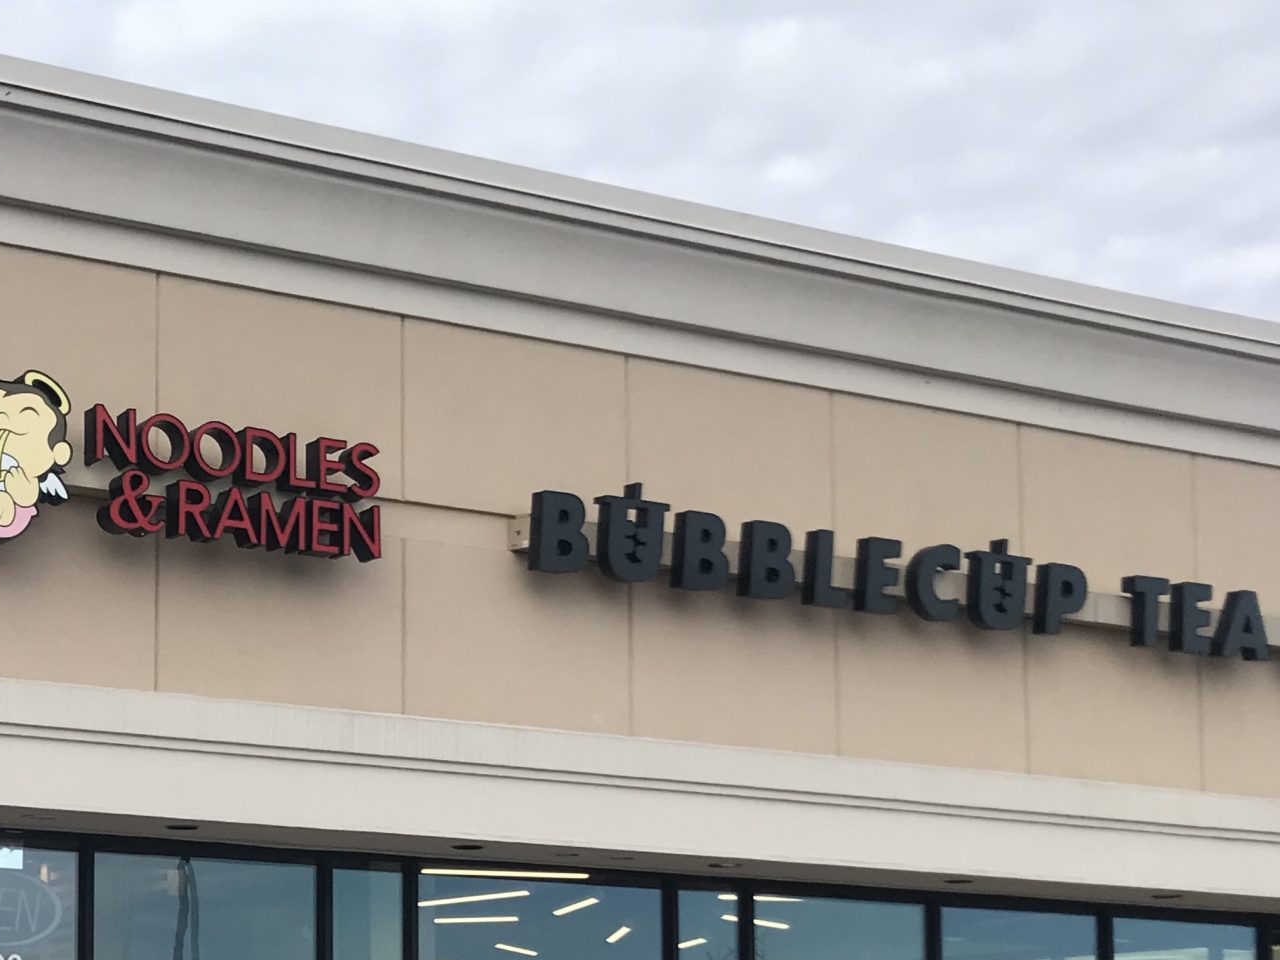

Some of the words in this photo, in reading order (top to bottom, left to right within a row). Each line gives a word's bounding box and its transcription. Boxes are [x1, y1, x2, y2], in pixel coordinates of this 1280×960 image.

[85, 403, 381, 500] NOODLES
[98, 469, 166, 536] &
[167, 479, 382, 563] RAMEN
[1121, 574, 1269, 661] TEA
